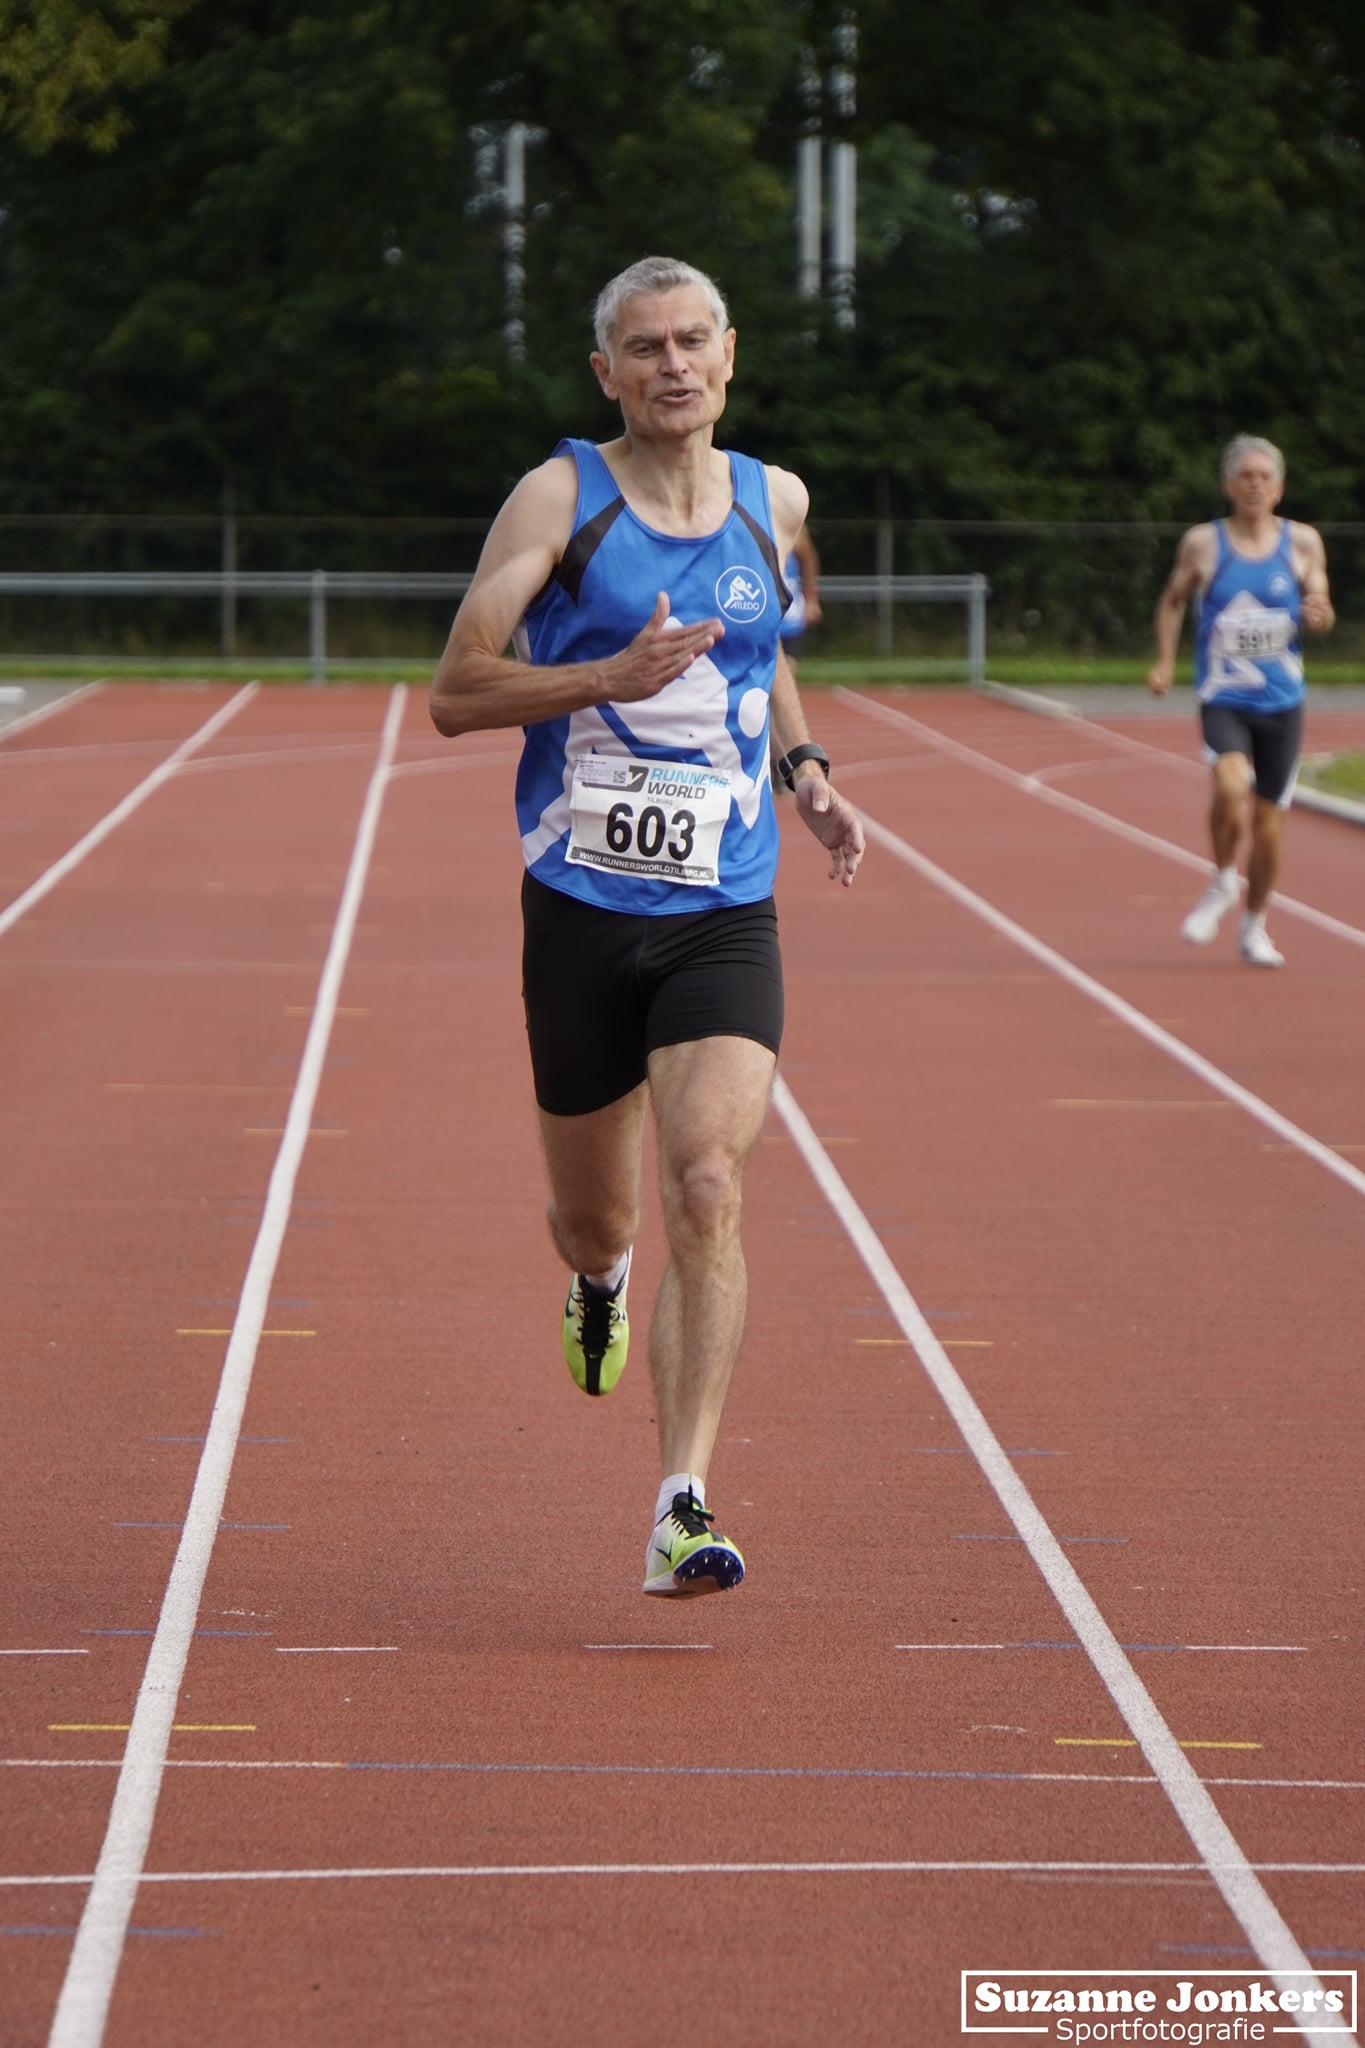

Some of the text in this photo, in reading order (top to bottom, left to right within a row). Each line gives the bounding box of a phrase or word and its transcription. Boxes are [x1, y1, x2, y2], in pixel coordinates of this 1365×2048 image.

[730, 601, 760, 611] ATLEDO
[650, 768, 729, 788] RUNNERS
[648, 782, 706, 799] WORLD
[647, 797, 673, 806] TILBURG
[606, 802, 696, 861] 603
